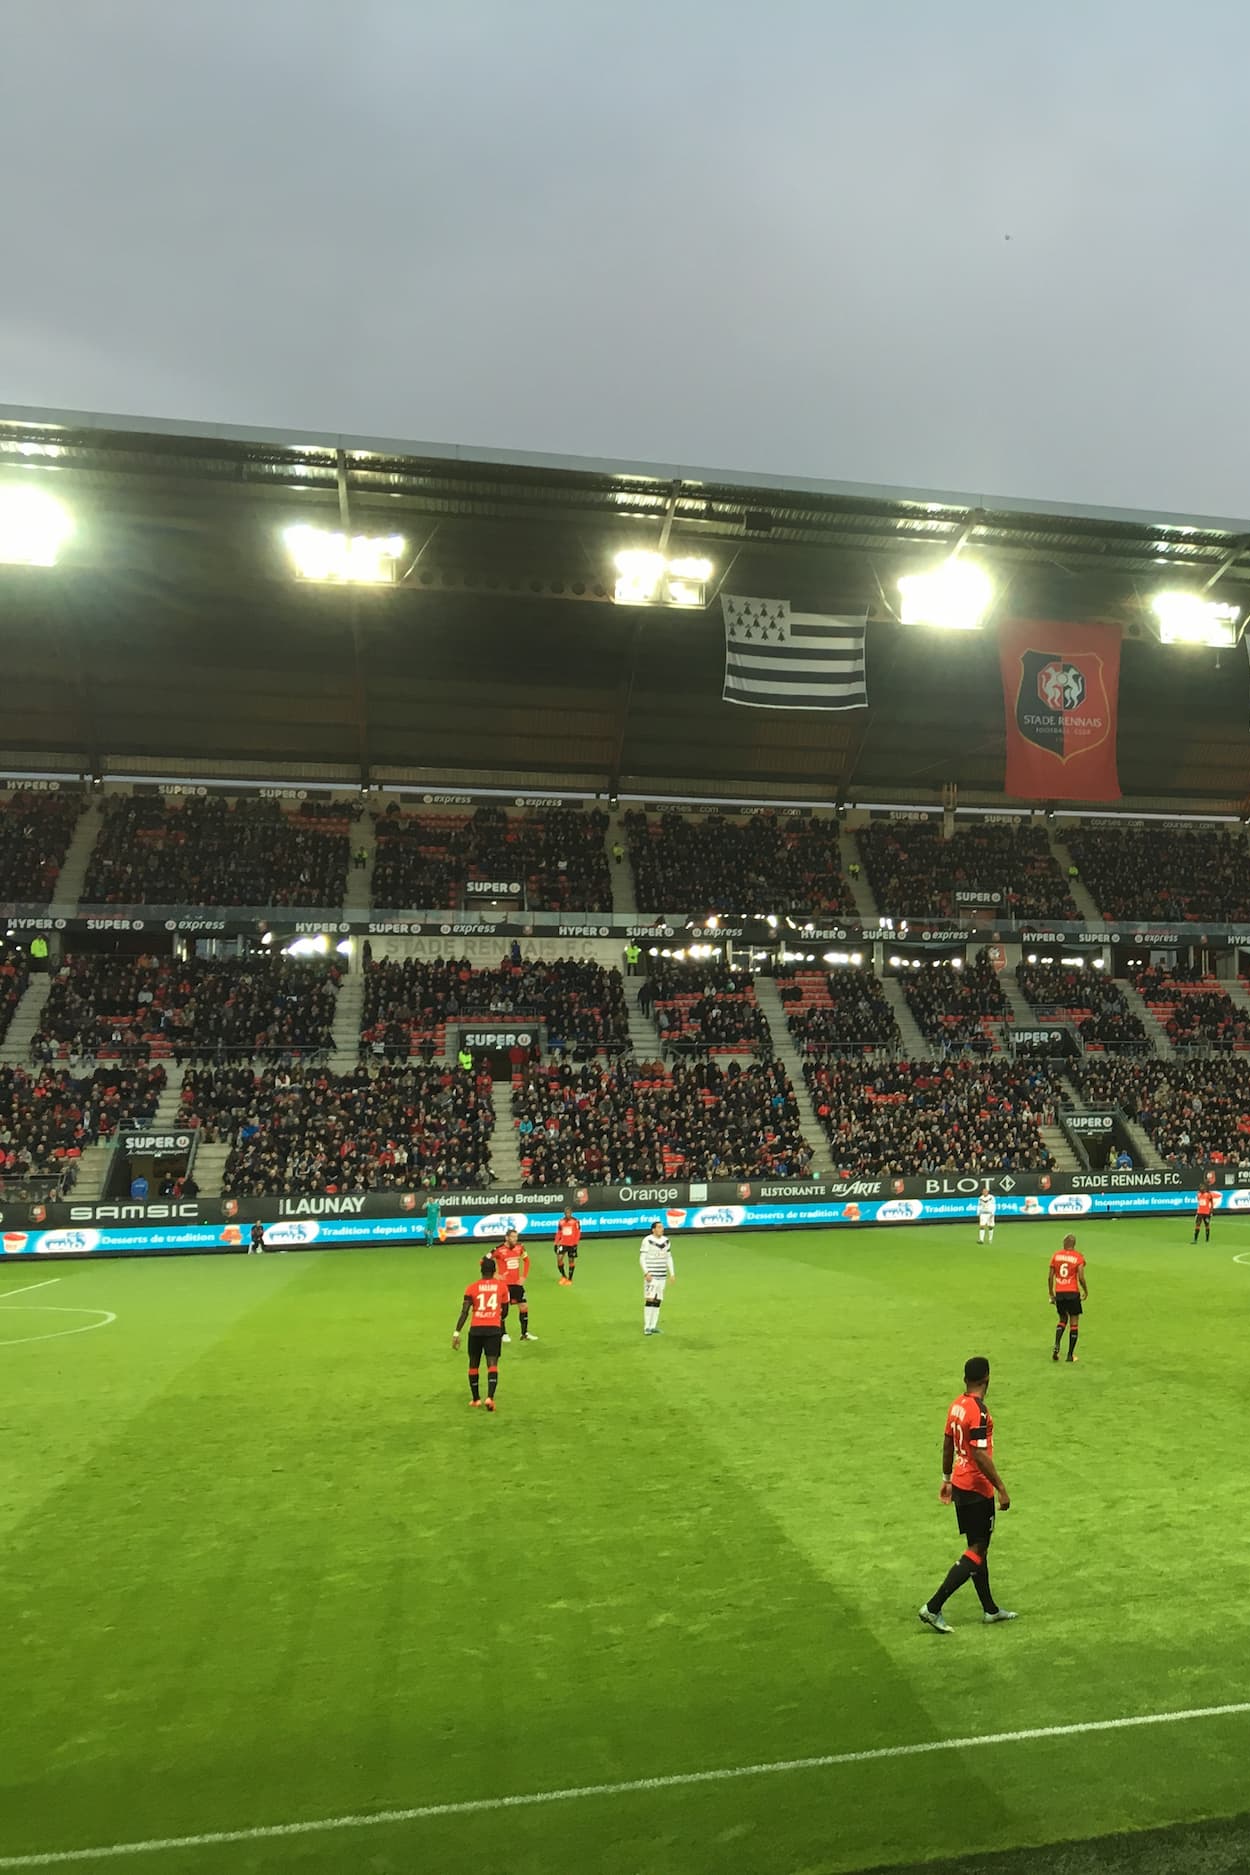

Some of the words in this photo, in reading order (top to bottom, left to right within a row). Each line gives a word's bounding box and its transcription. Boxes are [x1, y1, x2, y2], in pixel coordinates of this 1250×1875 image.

[1024, 714, 1056, 726] STADE
[1058, 715, 1102, 728] RENNAIS
[7, 781, 48, 790] HYPER
[158, 785, 196, 795] SUPER
[259, 789, 296, 799] SUPER
[466, 881, 508, 893] SUPER
[955, 892, 991, 902] SUPER
[8, 919, 53, 929] HYPER
[87, 920, 130, 930] SUPER
[178, 920, 225, 931] express
[296, 923, 338, 932] HYPER
[368, 923, 409, 933] SUPER
[453, 924, 496, 935] express
[559, 927, 597, 936] HYPER
[626, 927, 666, 937] SUPER
[703, 928, 743, 937] express
[801, 930, 836, 939] HYPER
[862, 930, 896, 940] SUPER
[932, 931, 969, 940] express
[1023, 933, 1056, 942] HYPER
[1079, 934, 1110, 943] SUPER
[1144, 934, 1178, 943] express
[465, 1034, 517, 1046] SUPER
[1066, 1116, 1103, 1128] SUPER
[125, 1136, 175, 1148] SUPER
[926, 1177, 994, 1193] BLOT
[1072, 1175, 1109, 1188] STADE
[1111, 1173, 1161, 1187] RENNAIS
[1164, 1173, 1183, 1185] F.C.
[619, 1187, 679, 1204] Orange
[760, 1185, 827, 1198] RISTORANTE
[434, 1192, 461, 1206] rédit
[461, 1191, 499, 1205] Mutuel
[500, 1191, 513, 1203] de
[515, 1189, 564, 1205] Bretagne
[1095, 1197, 1150, 1208] Incomparable
[1150, 1196, 1183, 1207] fromage
[1184, 1195, 1199, 1205] frai
[285, 1196, 367, 1215] LAUNAY
[925, 1205, 965, 1214] Tradition
[70, 1203, 199, 1221] SAMSIC
[747, 1211, 784, 1221] Desserts
[786, 1210, 798, 1219] de
[799, 1208, 839, 1219] tradition
[599, 1214, 639, 1226] fromage
[640, 1213, 661, 1223] frais
[321, 1227, 371, 1237] Tradition
[372, 1225, 408, 1236] depuis
[102, 1234, 149, 1245] Desserts
[150, 1232, 164, 1243] de
[166, 1231, 215, 1242] tradition
[1060, 1263, 1069, 1278] 6
[476, 1293, 498, 1311] 14
